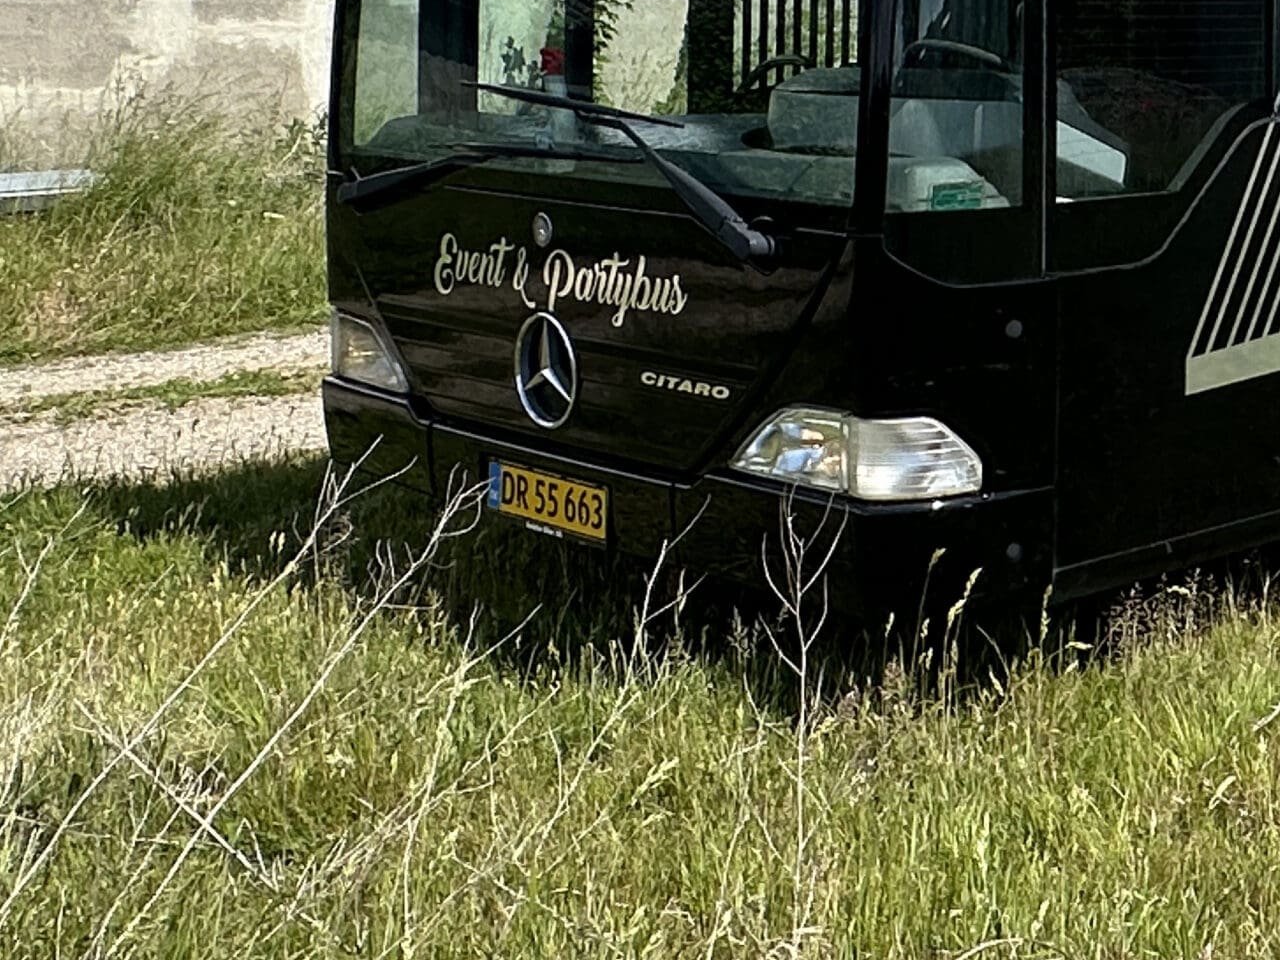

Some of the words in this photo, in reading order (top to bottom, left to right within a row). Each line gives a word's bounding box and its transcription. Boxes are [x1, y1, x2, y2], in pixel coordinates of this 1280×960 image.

[434, 233, 515, 295] Event
[512, 246, 536, 309] &
[543, 248, 688, 328] Partybus
[640, 371, 731, 399] CITARO
[502, 471, 529, 511] DR
[535, 479, 559, 518] 55
[564, 486, 603, 530] 663
